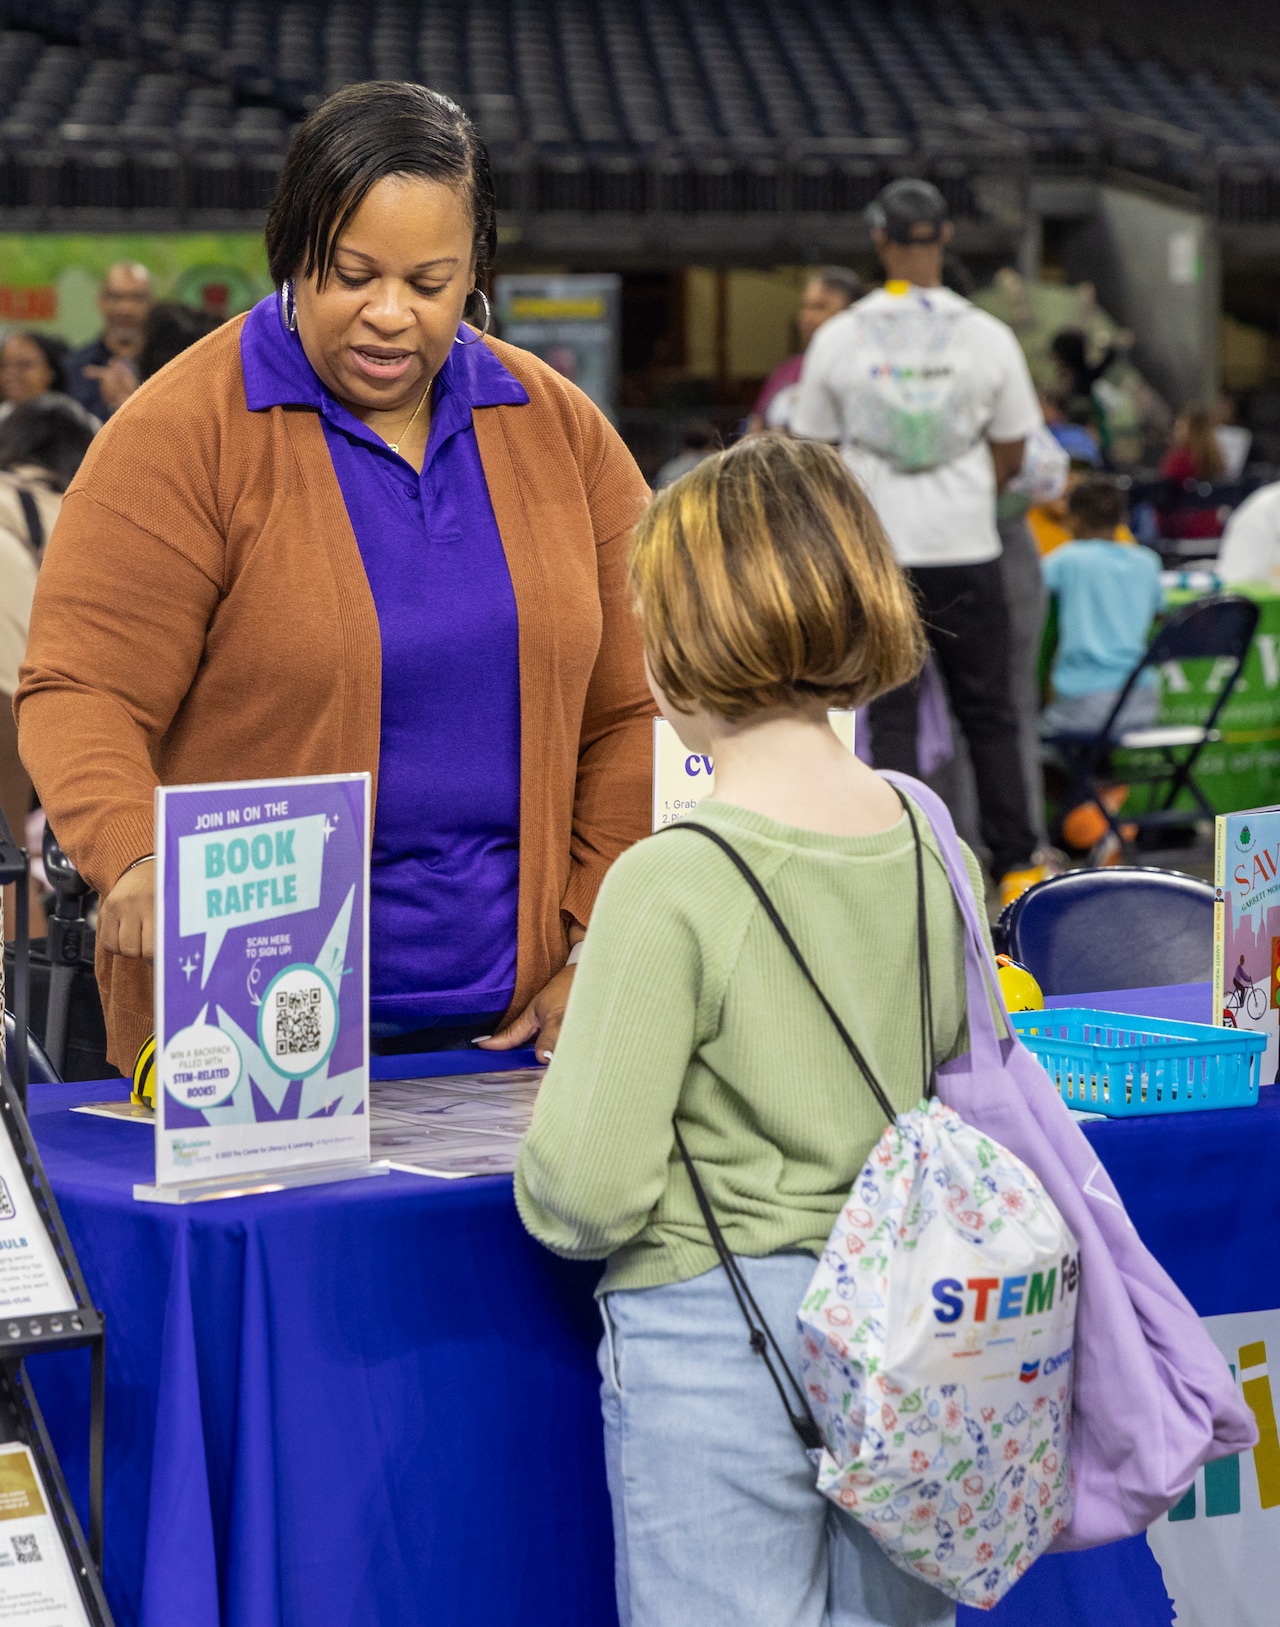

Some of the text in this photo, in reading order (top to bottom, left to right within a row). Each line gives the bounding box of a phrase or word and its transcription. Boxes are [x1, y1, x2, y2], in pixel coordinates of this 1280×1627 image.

[664, 799, 697, 810] 1. Grab
[195, 801, 289, 830] JOIN IN ON THE
[662, 814, 671, 824] 2.
[204, 829, 296, 879] BOOK
[206, 874, 298, 919] RAFFLE
[1241, 890, 1266, 912] GARRETT
[246, 933, 290, 948] SCAN HERE
[246, 945, 292, 958] TO SIGN UP!
[170, 1051, 185, 1060] WIN
[193, 1045, 231, 1057] BACKPACK
[179, 1057, 223, 1069] FILLED WITH
[173, 1067, 230, 1084] STEM-RELATED
[187, 1085, 216, 1098] BOOKS!
[932, 1266, 1058, 1324] STEM
